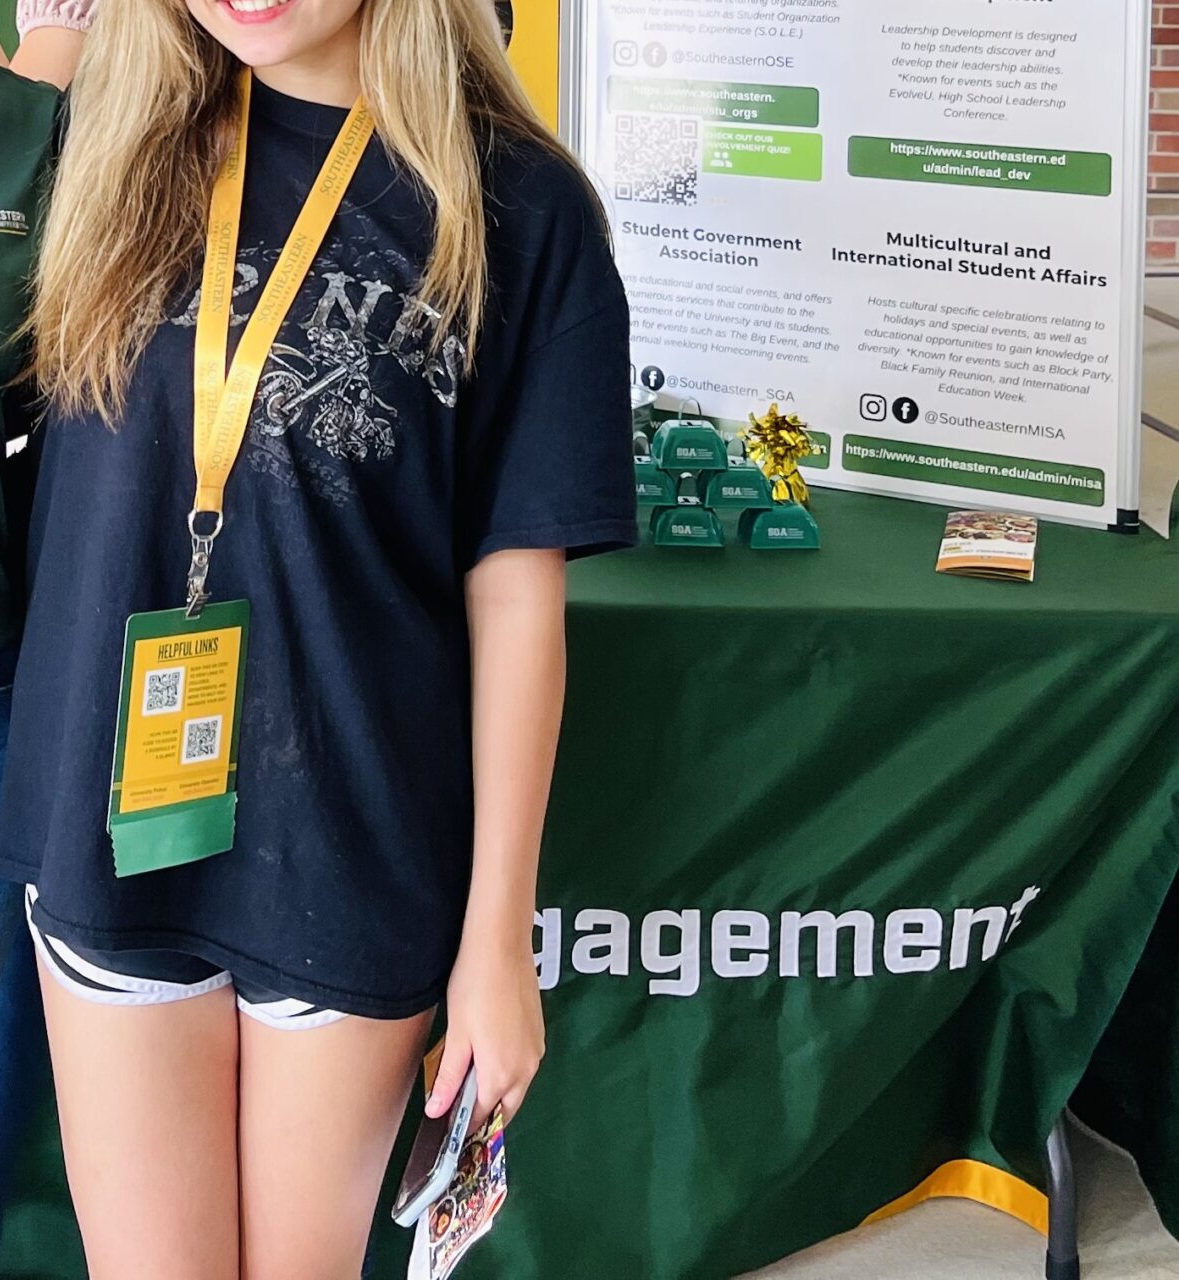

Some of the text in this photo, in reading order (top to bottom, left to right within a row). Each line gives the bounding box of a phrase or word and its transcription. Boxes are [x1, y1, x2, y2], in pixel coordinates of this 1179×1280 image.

[880, 24, 1078, 43] Leadership Development is designed
[900, 41, 1056, 58] to help students discover and
[890, 56, 933, 70] develop
[935, 58, 959, 69] their
[960, 59, 1017, 74] leadership
[940, 74, 955, 85] for
[956, 77, 993, 88] events
[995, 78, 1022, 89] such
[1023, 81, 1038, 90] as
[1040, 80, 1058, 91] the
[938, 91, 963, 104] High
[965, 92, 1003, 105] School
[1004, 95, 1067, 110] Leadership
[320, 106, 368, 196] SOUTHEASTERN
[889, 142, 1066, 165] https://www.southeastern.ed
[922, 162, 1031, 180] u/admin/lead_dev
[621, 220, 802, 252] Student Government
[886, 231, 1051, 260] Multicultural and
[212, 221, 233, 313] SOUTHEASTERN
[658, 244, 758, 267] Association
[831, 246, 1107, 288] International Student Affairs
[257, 233, 308, 323] SOUTHEASTERN
[867, 296, 1106, 331] Hosts cultural specific celebrations relating to
[882, 312, 926, 328] holidays
[927, 319, 949, 330] and
[950, 322, 989, 334] special
[1032, 331, 1047, 341] as
[1048, 332, 1072, 343] well
[1073, 335, 1087, 345] as
[863, 327, 1109, 364] educational opportunities to gain knowledge of
[879, 359, 908, 372] Black
[910, 363, 947, 379] Family
[998, 375, 1020, 386] and
[1021, 377, 1091, 395] International
[948, 351, 963, 363] for
[964, 355, 1001, 368] events
[1003, 360, 1030, 371] such
[1031, 363, 1046, 373] as
[1048, 363, 1079, 376] Block
[667, 375, 795, 402] @Southeastern_SGA
[937, 382, 991, 398] Education
[924, 410, 1065, 440] @SoutheasternMISA
[845, 443, 1103, 490] https://www.southeastern.edu/admin/misa
[157, 637, 219, 660] HELPFUL LINKS
